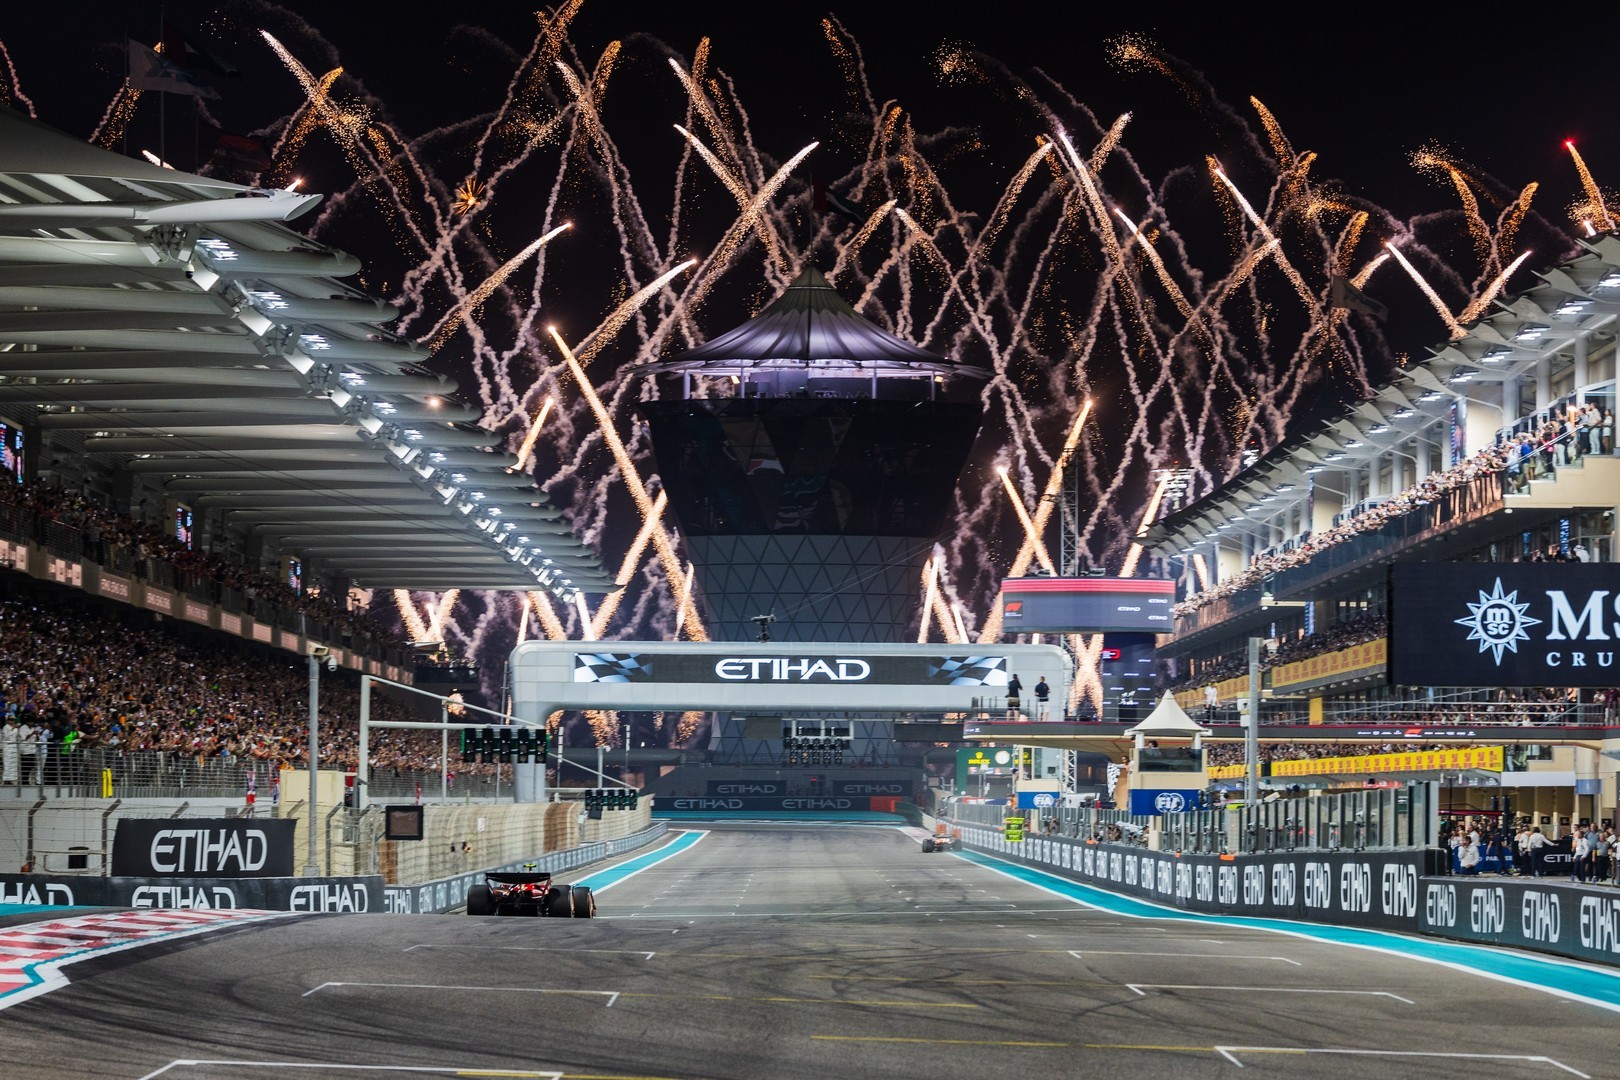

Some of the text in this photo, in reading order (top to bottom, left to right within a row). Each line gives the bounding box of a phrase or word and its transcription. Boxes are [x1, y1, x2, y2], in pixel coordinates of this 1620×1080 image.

[1545, 590, 1620, 640] M
[715, 658, 871, 681] ETIHAD
[673, 799, 744, 809] ETIHAD
[717, 784, 777, 794] ETIHAD
[781, 799, 852, 809] ETIHAD
[843, 784, 903, 794] ETIHAD
[150, 829, 267, 873] ETIHAD
[1543, 853, 1573, 863] ETIH
[132, 886, 236, 909] ETIHAD
[290, 884, 368, 913] ETIHAD
[1304, 862, 1331, 909] ETIHAD
[1341, 863, 1371, 913] ETIHAD
[1382, 863, 1417, 917] ETIHAD
[1426, 884, 1456, 927] ETIHAD
[1470, 887, 1505, 933] ETIHAD
[1521, 890, 1560, 943] ETIHAD
